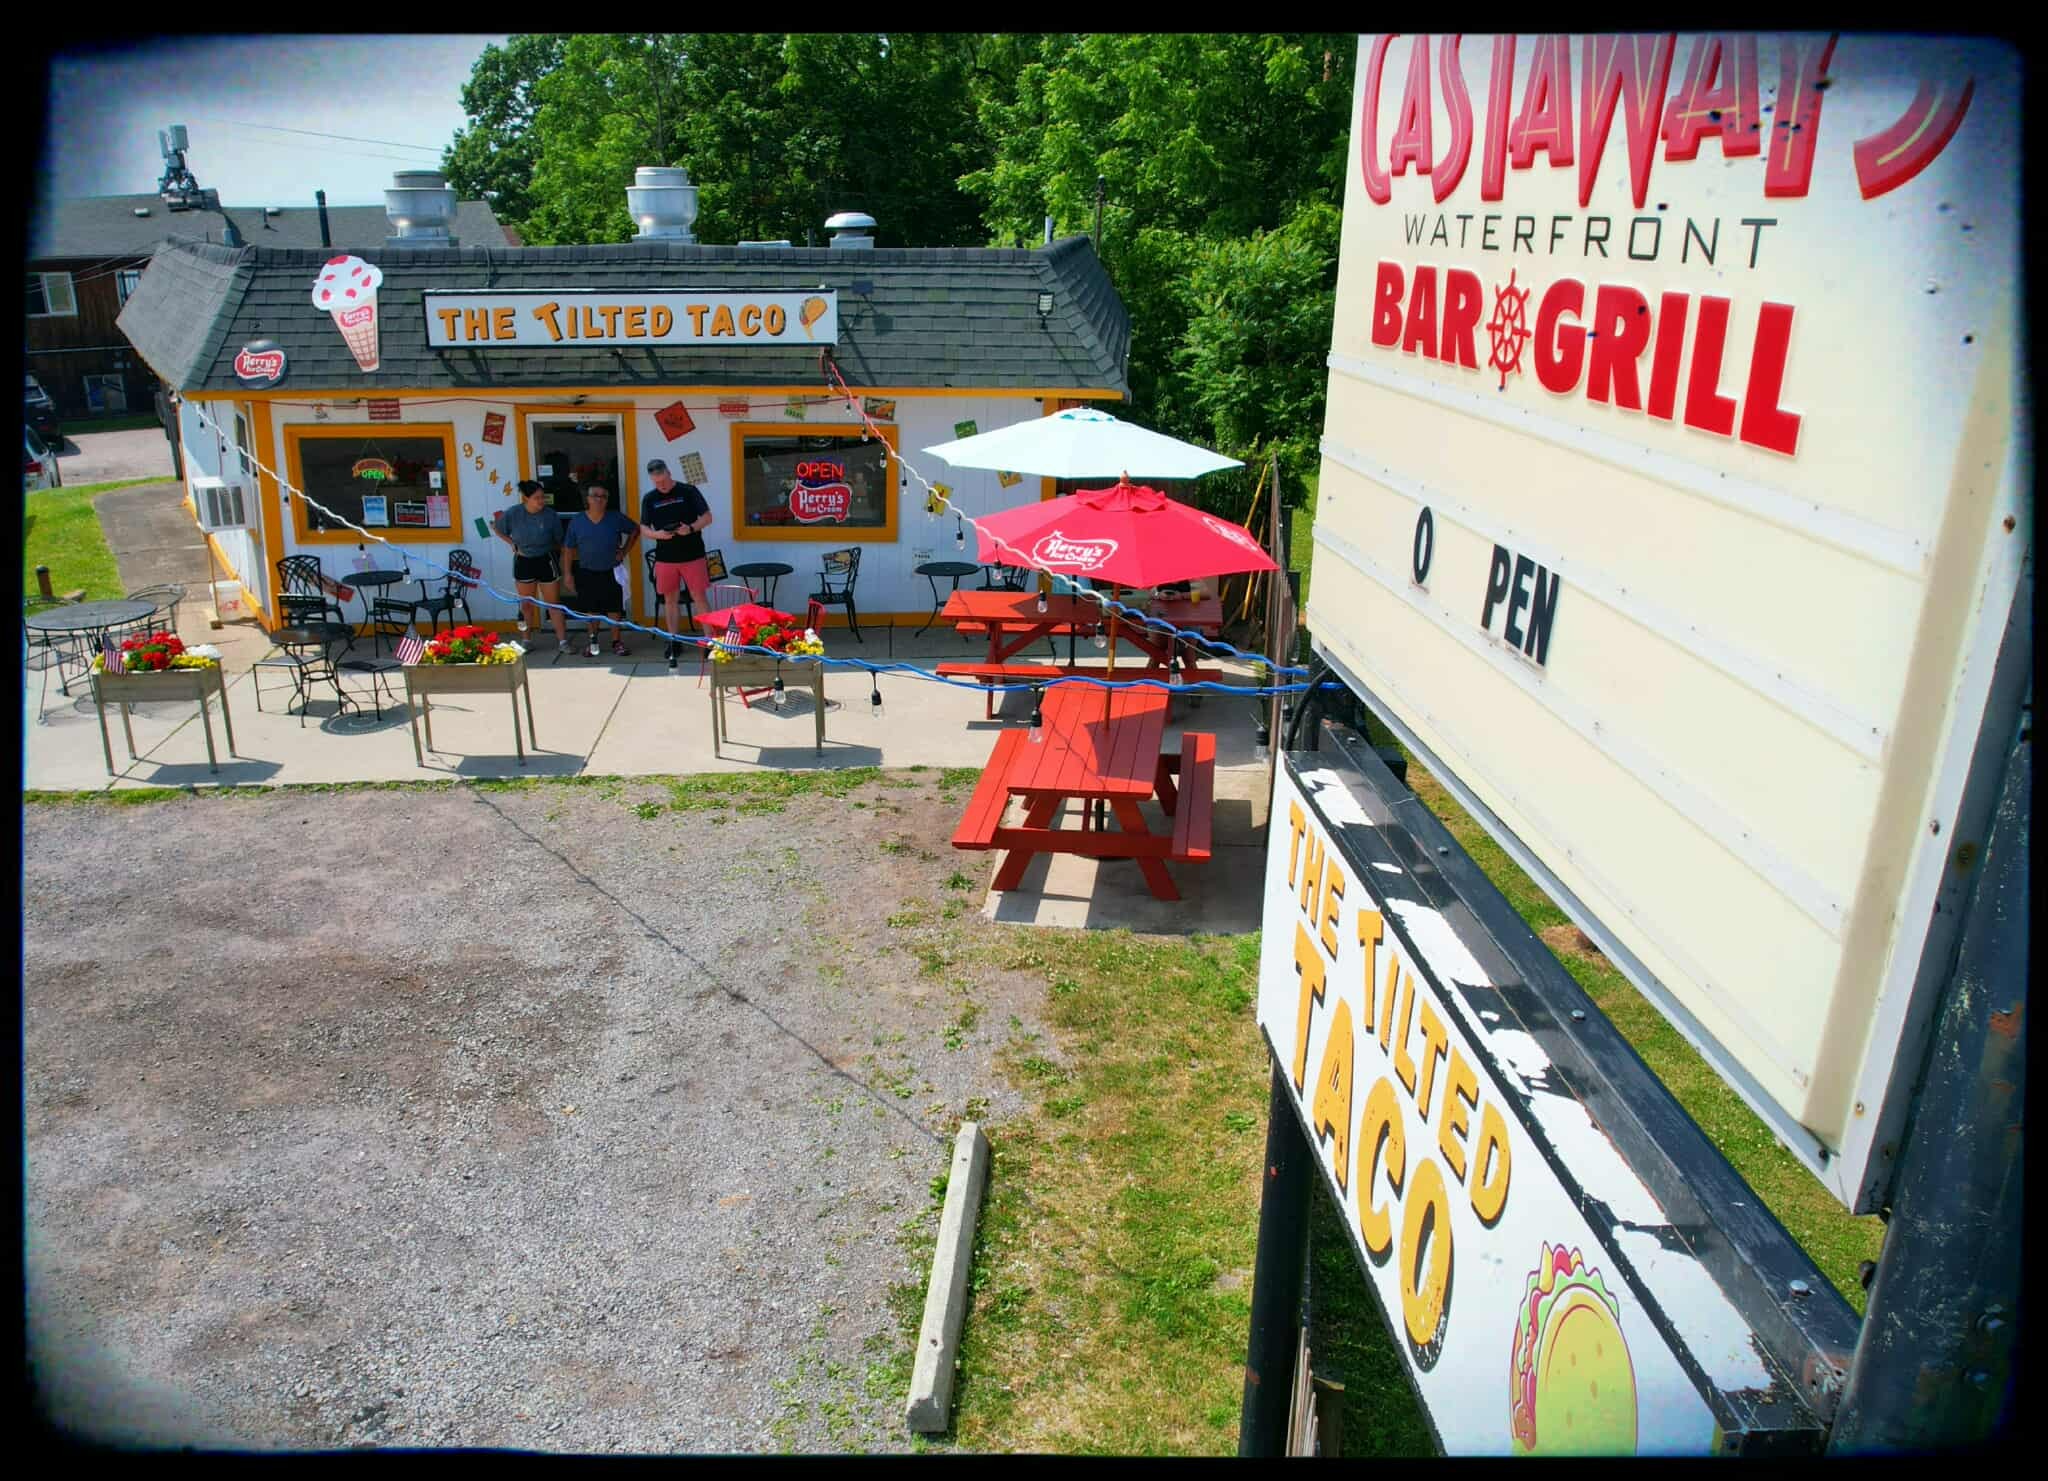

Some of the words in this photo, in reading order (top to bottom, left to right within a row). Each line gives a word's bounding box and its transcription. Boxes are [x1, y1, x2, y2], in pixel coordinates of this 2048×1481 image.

[1403, 212, 1778, 269] WATERFRONT
[437, 307, 516, 342] THE
[533, 302, 673, 342] TILTED
[687, 304, 786, 338] TACO
[1371, 262, 1484, 369] BAR
[1533, 278, 1803, 457] GRILL
[361, 470, 385, 480] OPEN
[796, 462, 844, 478] OPEN
[798, 490, 844, 509] Perry's
[1044, 536, 1104, 560] Perry's
[1480, 543, 1561, 667] PEN
[1288, 799, 1346, 960] THE
[1358, 907, 1510, 1229] TILTED
[1293, 921, 1454, 1374] TACO
